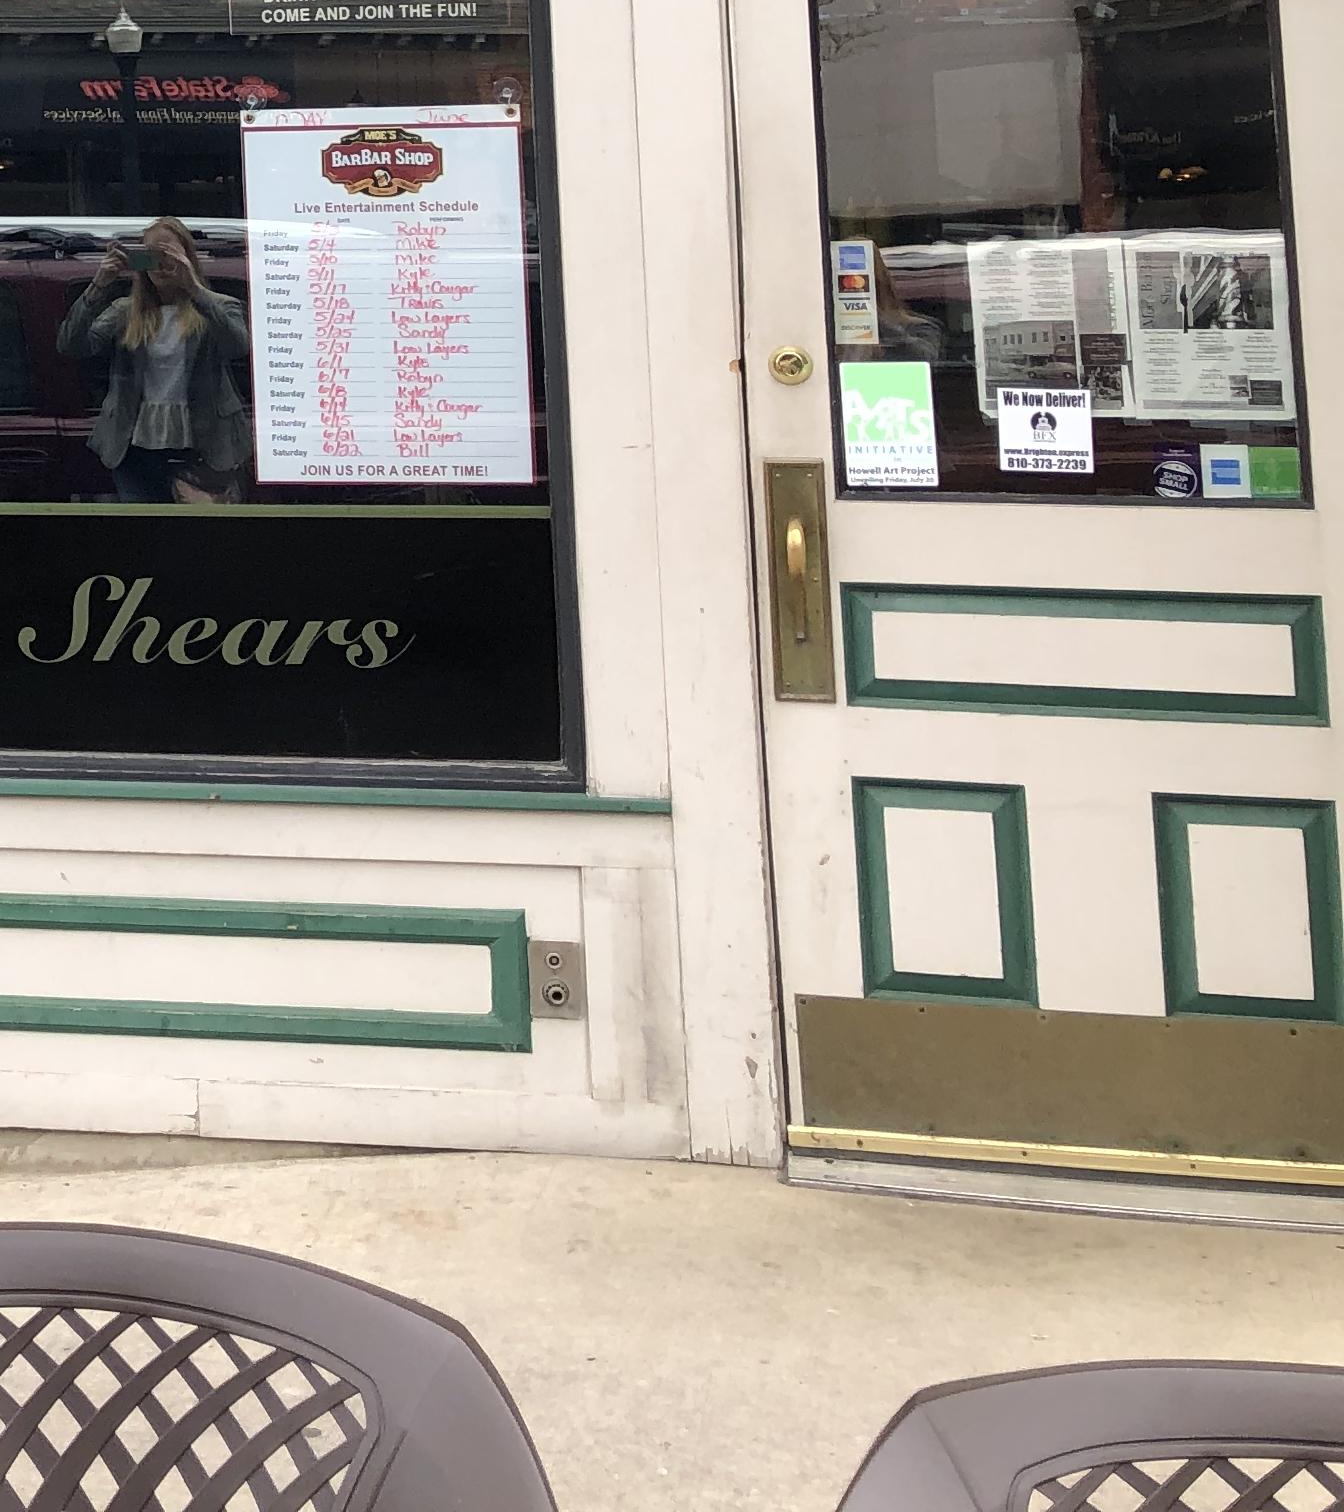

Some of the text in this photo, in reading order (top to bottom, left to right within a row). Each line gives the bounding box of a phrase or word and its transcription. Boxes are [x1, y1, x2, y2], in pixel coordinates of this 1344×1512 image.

[261, 1, 477, 24] COME AND JOIN THE FUN!
[365, 131, 396, 141] MOE'S
[395, 148, 434, 166] SHOP
[294, 201, 478, 214] Live Entertainment Schedule
[264, 244, 299, 253] Saturday
[264, 258, 289, 267] Friday
[265, 273, 300, 282] Saturday
[266, 287, 290, 296] Friday
[266, 302, 301, 311] Saturday
[844, 302, 868, 311] VISA
[267, 317, 291, 326] Friday
[268, 331, 302, 340] Saturday
[268, 346, 293, 355] Friday
[269, 360, 304, 369] Saturday
[269, 375, 294, 384] Friday
[270, 390, 305, 399] Saturday
[1003, 391, 1086, 408] We Now Deliver!
[270, 404, 295, 413] Friday
[271, 419, 306, 428] Saturday
[272, 434, 296, 443] Friday
[273, 449, 307, 458] Saturday
[849, 446, 933, 454] INITIATIVE
[1007, 457, 1087, 470] 810-373-2239
[300, 464, 488, 476] JOIN US FOR A GREAT TIME!
[849, 467, 882, 475] Howell
[901, 467, 935, 476] Project
[1163, 471, 1189, 482] SHOP
[1159, 478, 1189, 491] SMALL
[17, 574, 416, 669] Shears
